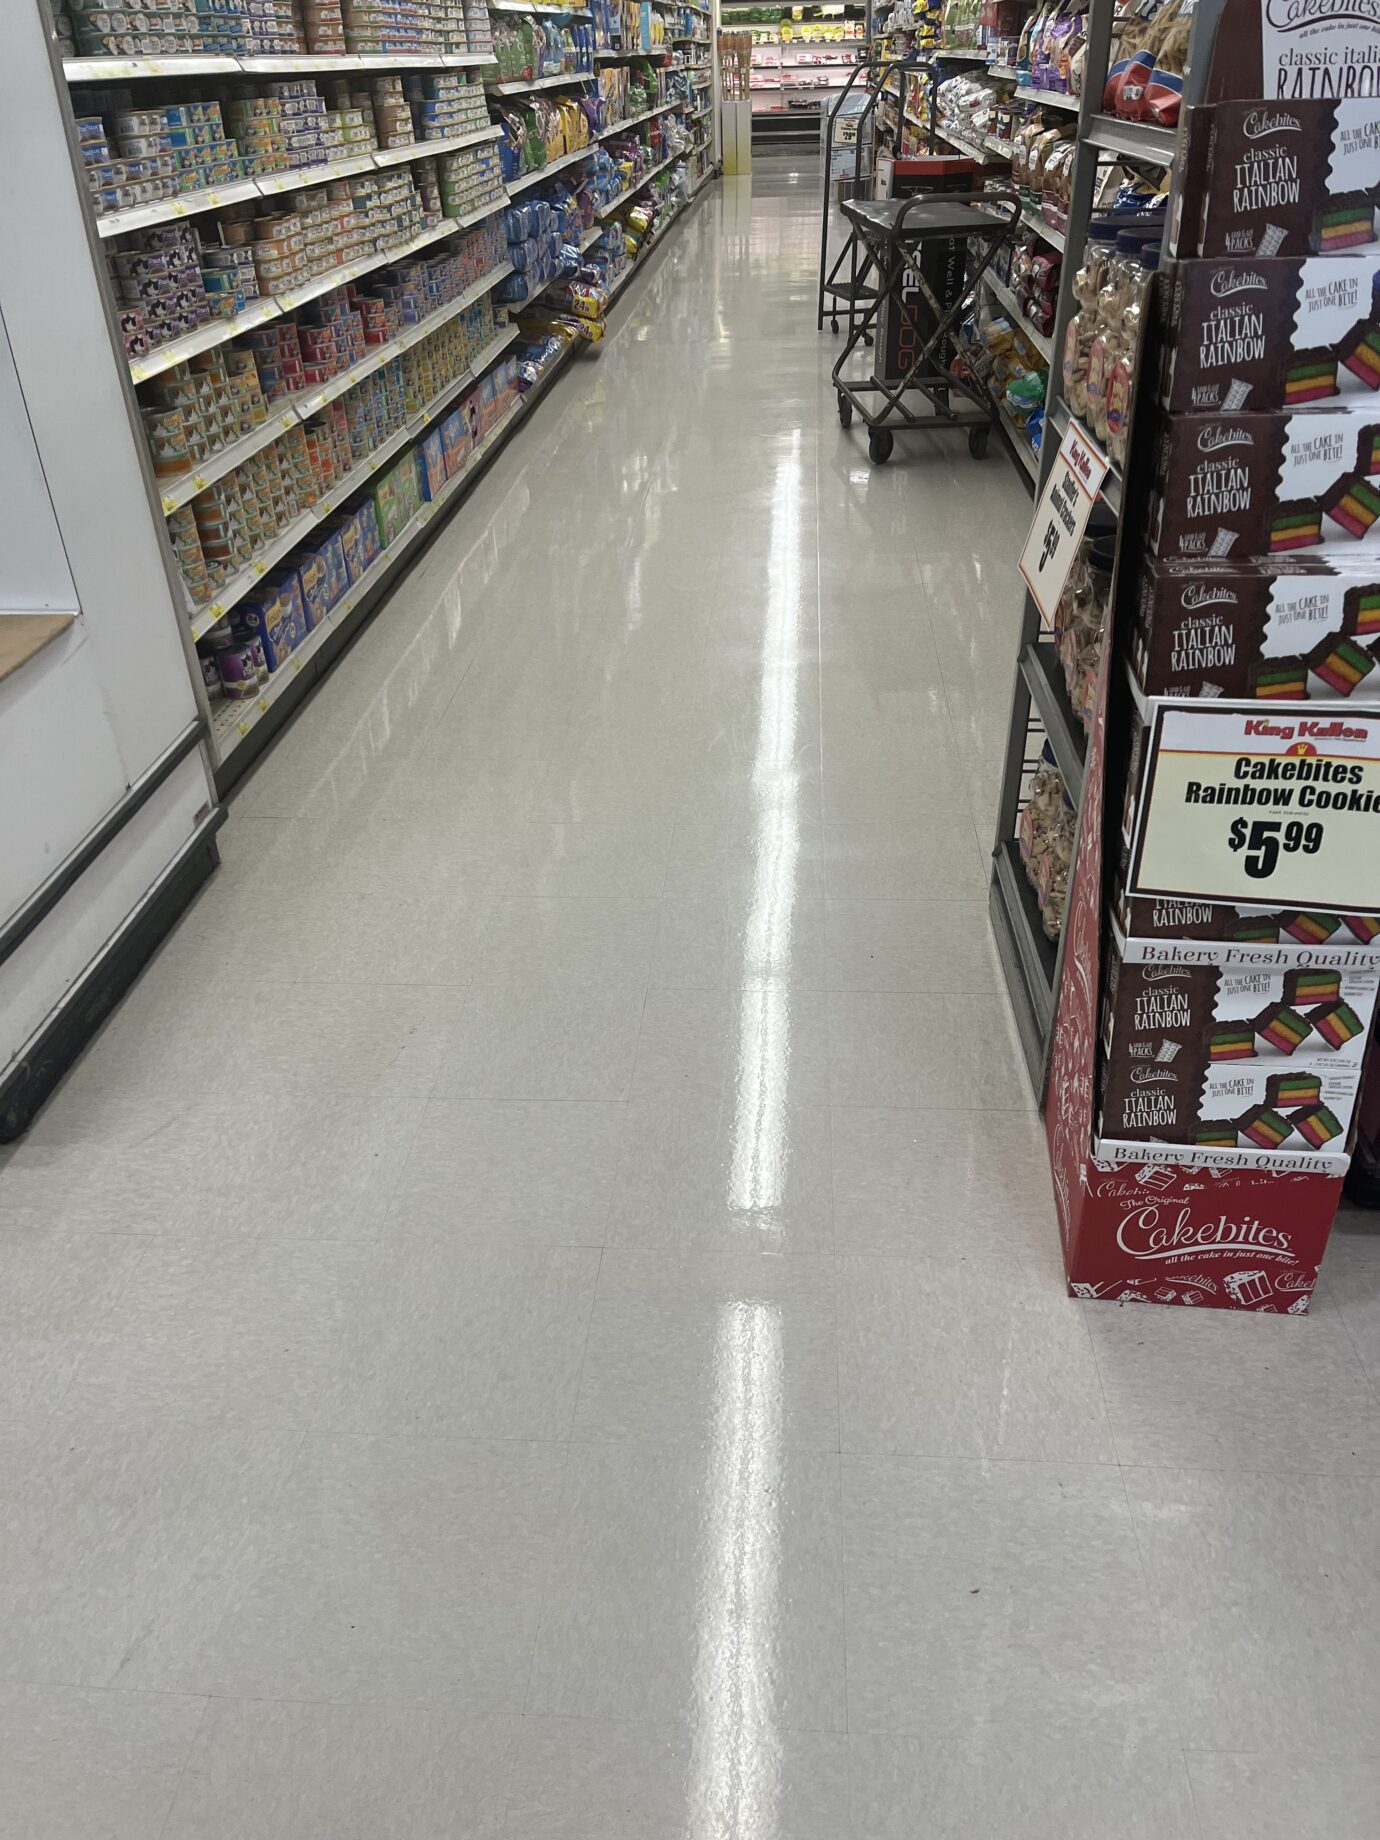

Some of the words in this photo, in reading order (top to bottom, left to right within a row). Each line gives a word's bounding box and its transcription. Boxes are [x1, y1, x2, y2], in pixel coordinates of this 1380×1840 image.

[1278, 47, 1338, 66] classic
[1243, 111, 1301, 139] Cakebites
[1340, 131, 1351, 142] ALL
[1352, 128, 1362, 139] THE
[1243, 144, 1287, 163] classic
[1344, 141, 1358, 156] JUST
[1359, 138, 1372, 150] ONE
[1235, 155, 1297, 188] ITALIAN
[1233, 179, 1300, 213] RAINBOW
[1231, 237, 1253, 251] PACKS
[946, 256, 956, 285] Well
[1211, 270, 1267, 297] Cakebites
[1305, 288, 1316, 299] ALL
[1317, 286, 1327, 298] THE
[1328, 281, 1347, 296] CAKE
[1349, 278, 1358, 288] IN
[1210, 302, 1253, 320] classic
[1308, 300, 1322, 313] JUST
[1323, 296, 1336, 308] ONE
[1338, 291, 1358, 307] BITE!
[1202, 313, 1263, 345] ITALIAN
[1200, 336, 1265, 368] RAINBOW
[1197, 391, 1218, 405] PACKS
[1198, 427, 1253, 452] Cakebites
[1290, 443, 1302, 455] ALL
[1303, 441, 1312, 452] THE
[1313, 436, 1332, 450] CAKE
[1334, 433, 1343, 444] IN
[1197, 456, 1239, 473] classic
[1293, 453, 1308, 467] JUST
[1309, 450, 1322, 461] ONE
[1323, 445, 1343, 461] BITE!
[1189, 467, 1249, 496] ITALIAN
[1186, 487, 1251, 518] RAINBOW
[1184, 540, 1205, 551] PACKS
[1181, 584, 1238, 609] Cakebites
[1275, 602, 1287, 613] ALL
[1287, 600, 1297, 612] THE
[1298, 596, 1318, 610] CAKE
[1320, 594, 1329, 605] IN
[1181, 614, 1223, 629] classic
[1278, 613, 1292, 625] JUST
[1293, 609, 1307, 620] ONE
[1308, 605, 1328, 621] BITE!
[1173, 624, 1233, 651] ITALIAN
[1171, 644, 1235, 672] RAINBOW
[1244, 719, 1294, 739] King
[1297, 721, 1368, 739] Kullen
[1234, 757, 1364, 784] Cakebites
[1185, 781, 1294, 806] Rainbow
[1153, 905, 1212, 927] RAINBOW
[1142, 946, 1219, 965] Bakery
[1224, 949, 1288, 965] Fresh
[1296, 950, 1380, 970] Quality
[1142, 964, 1192, 981] Cakebites
[1224, 979, 1233, 987] ALL
[1234, 978, 1242, 986] THE
[1244, 975, 1261, 984] CAKE
[1263, 973, 1271, 982] IN
[1142, 985, 1180, 997] classic
[1227, 986, 1239, 996] JUST
[1240, 984, 1251, 993] ONE
[1252, 982, 1270, 993] BITE!
[1135, 994, 1188, 1014] ITALIAN
[1134, 1010, 1190, 1030] RAINBOW
[1134, 1047, 1153, 1056] PACKS
[1130, 1067, 1178, 1083] Cakebites
[1209, 1083, 1218, 1091] ALL
[1219, 1081, 1228, 1090] THE
[1228, 1079, 1245, 1089] CAKE
[1246, 1078, 1254, 1087] IN
[1130, 1087, 1167, 1098] classic
[1212, 1090, 1224, 1098] JUST
[1225, 1088, 1236, 1096] ONE
[1236, 1086, 1254, 1096] BITE!
[1124, 1095, 1174, 1113] ITALIAN
[1122, 1110, 1176, 1129] RAINBOW
[1114, 1147, 1185, 1163] Bakery
[1190, 1152, 1249, 1167] Fresh
[1255, 1153, 1333, 1171] Quality
[1119, 1198, 1143, 1210] The
[1145, 1195, 1190, 1205] Original
[1116, 1203, 1293, 1256] Cakebites
[1165, 1256, 1179, 1265] all
[1181, 1254, 1195, 1262] the
[1223, 1250, 1233, 1258] in
[1234, 1250, 1255, 1259] just
[1256, 1252, 1273, 1261] one
[1275, 1255, 1299, 1265] bite!
